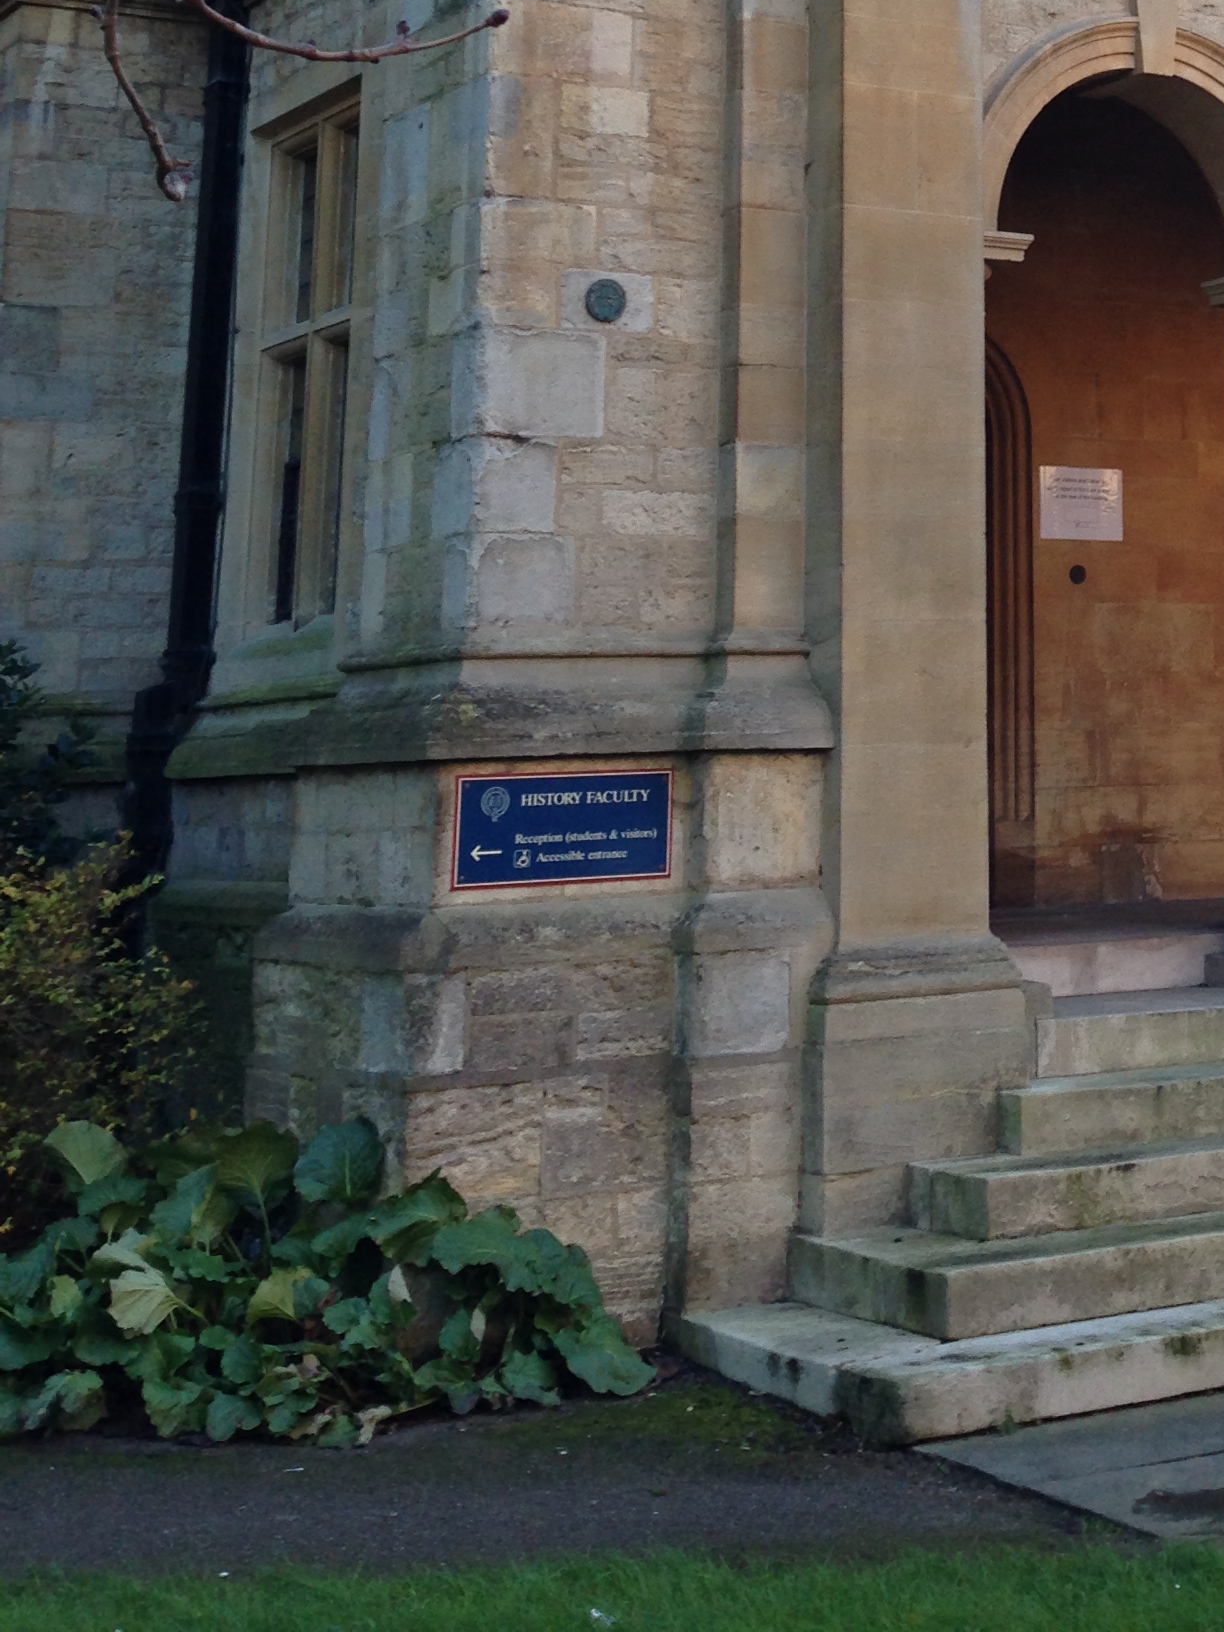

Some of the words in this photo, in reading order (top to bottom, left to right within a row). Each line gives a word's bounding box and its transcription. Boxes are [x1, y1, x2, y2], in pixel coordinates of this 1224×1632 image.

[521, 792, 582, 806] HISTORY
[586, 789, 650, 803] FACULTY
[515, 833, 563, 845] Reception
[565, 831, 607, 843] (students
[609, 829, 618, 839] &
[621, 828, 657, 839] visitors)
[536, 850, 585, 862] Accessible
[588, 850, 627, 860] entrance
